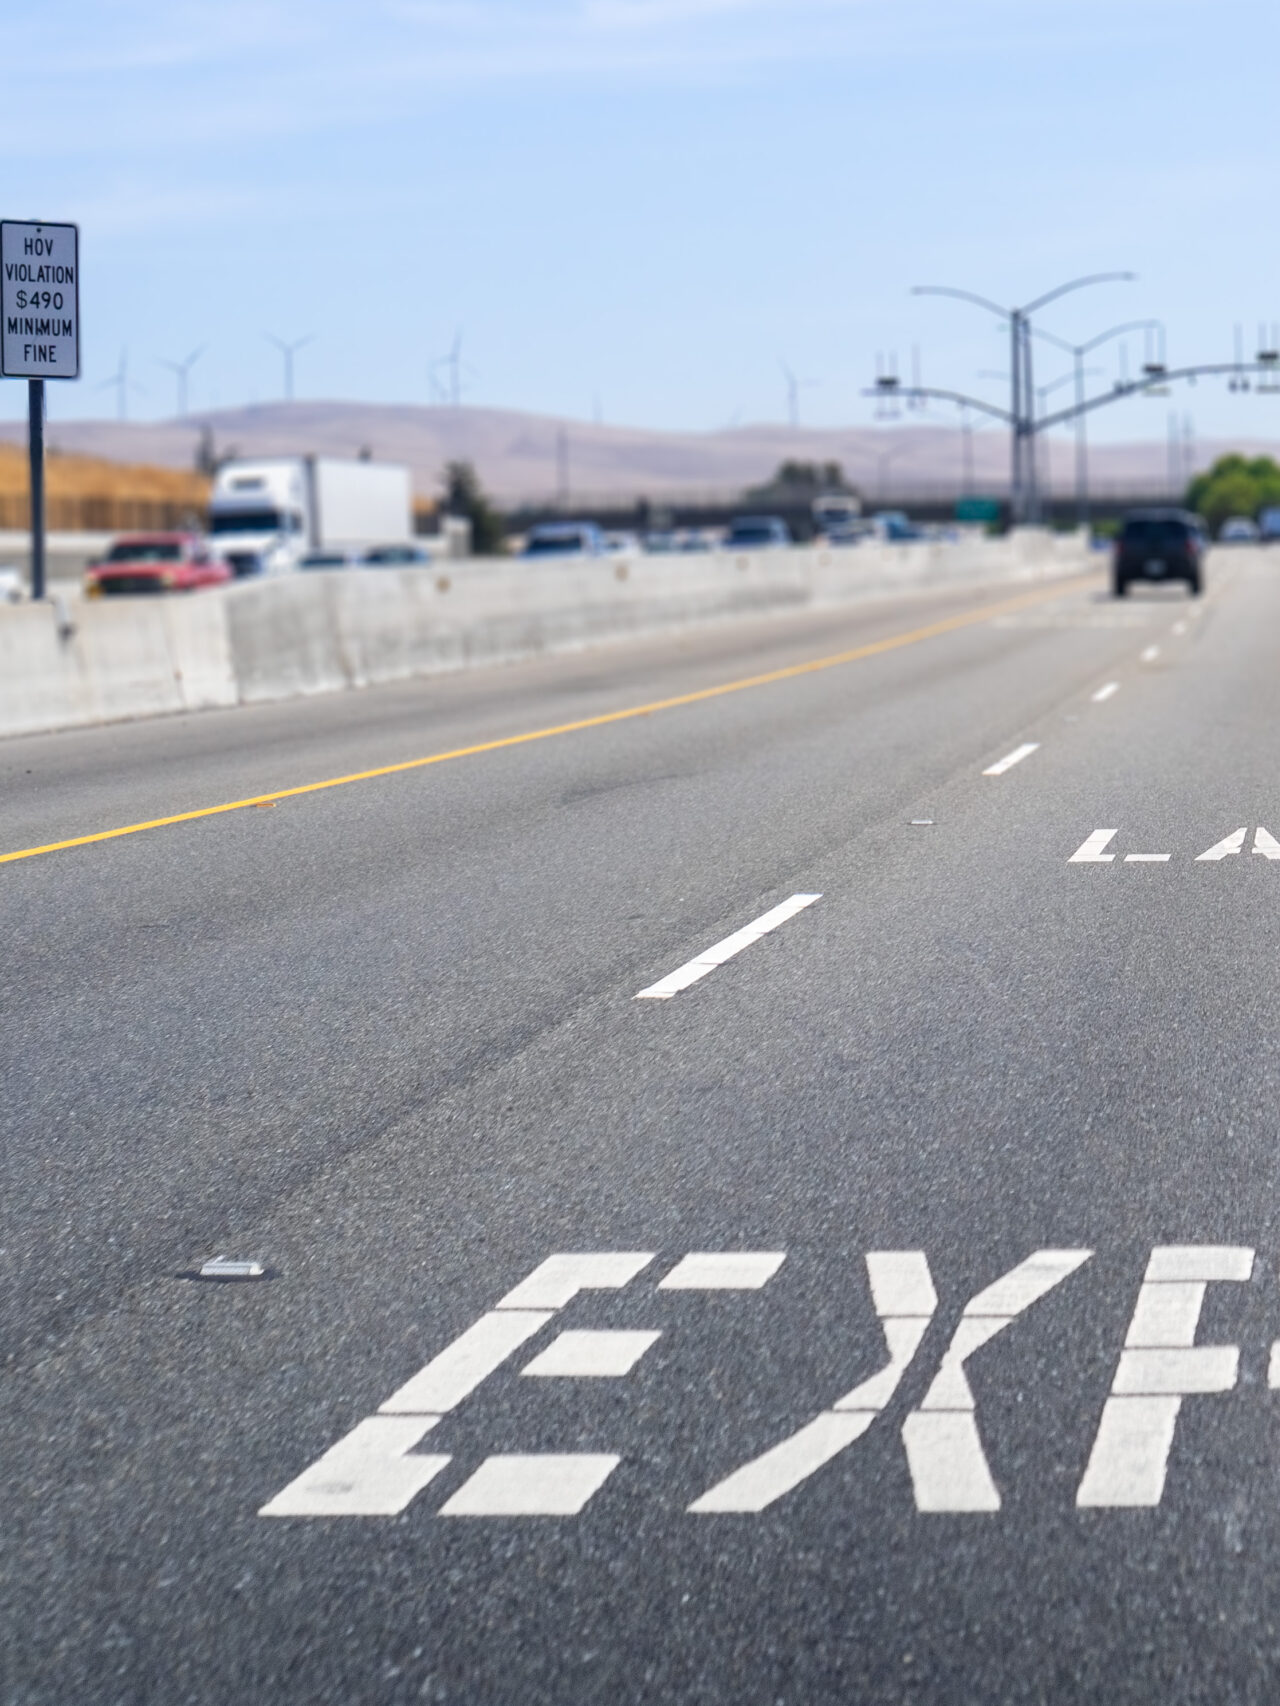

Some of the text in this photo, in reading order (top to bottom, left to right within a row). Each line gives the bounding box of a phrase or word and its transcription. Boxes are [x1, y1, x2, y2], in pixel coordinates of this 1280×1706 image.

[24, 237, 54, 256] HOV
[5, 263, 74, 284] VIOLATION
[16, 289, 64, 310] $490
[7, 316, 73, 337] MINIMUM
[24, 344, 57, 363] FINE
